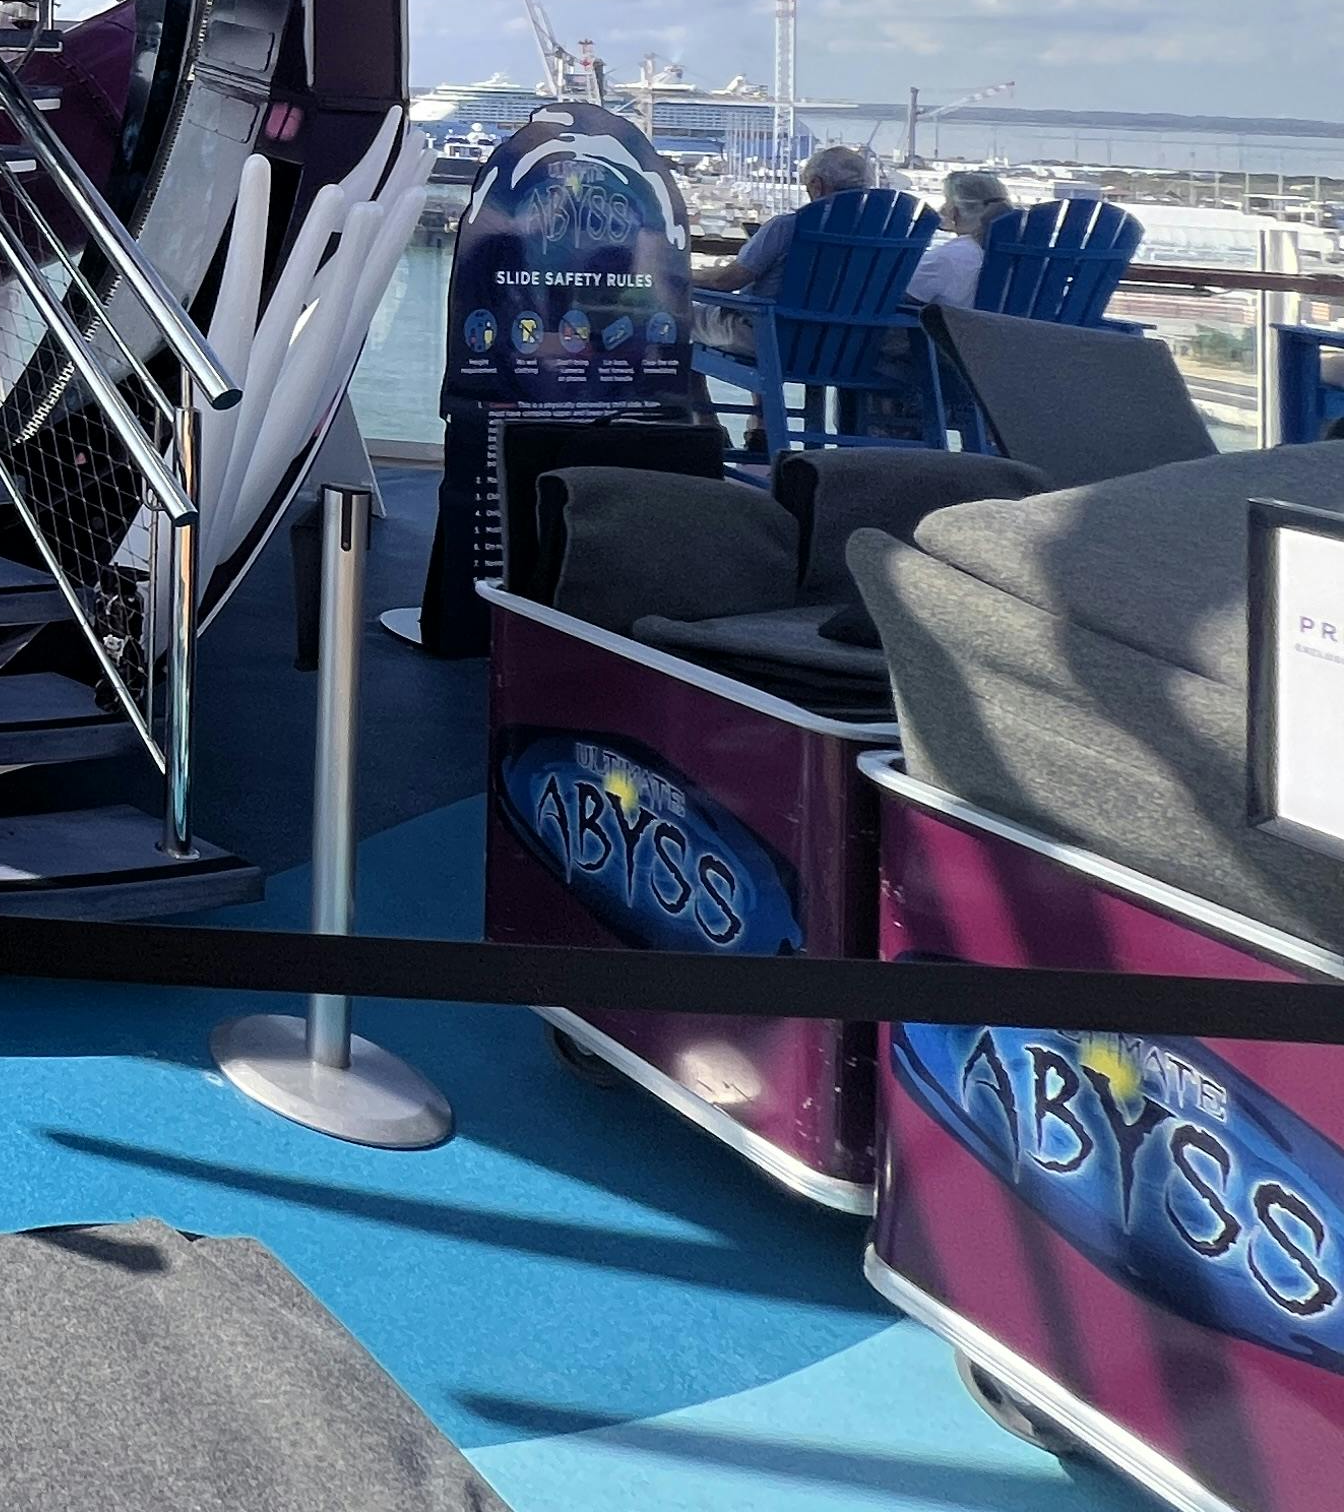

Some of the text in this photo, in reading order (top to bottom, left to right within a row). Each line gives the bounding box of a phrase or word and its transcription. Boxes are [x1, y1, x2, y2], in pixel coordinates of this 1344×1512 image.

[526, 184, 630, 255] ABYSS
[496, 271, 653, 288] SLIDE SAFETY RULES
[1299, 615, 1344, 643] PR
[535, 772, 744, 947] ABYSS
[962, 1026, 1340, 1320] ABYSS
